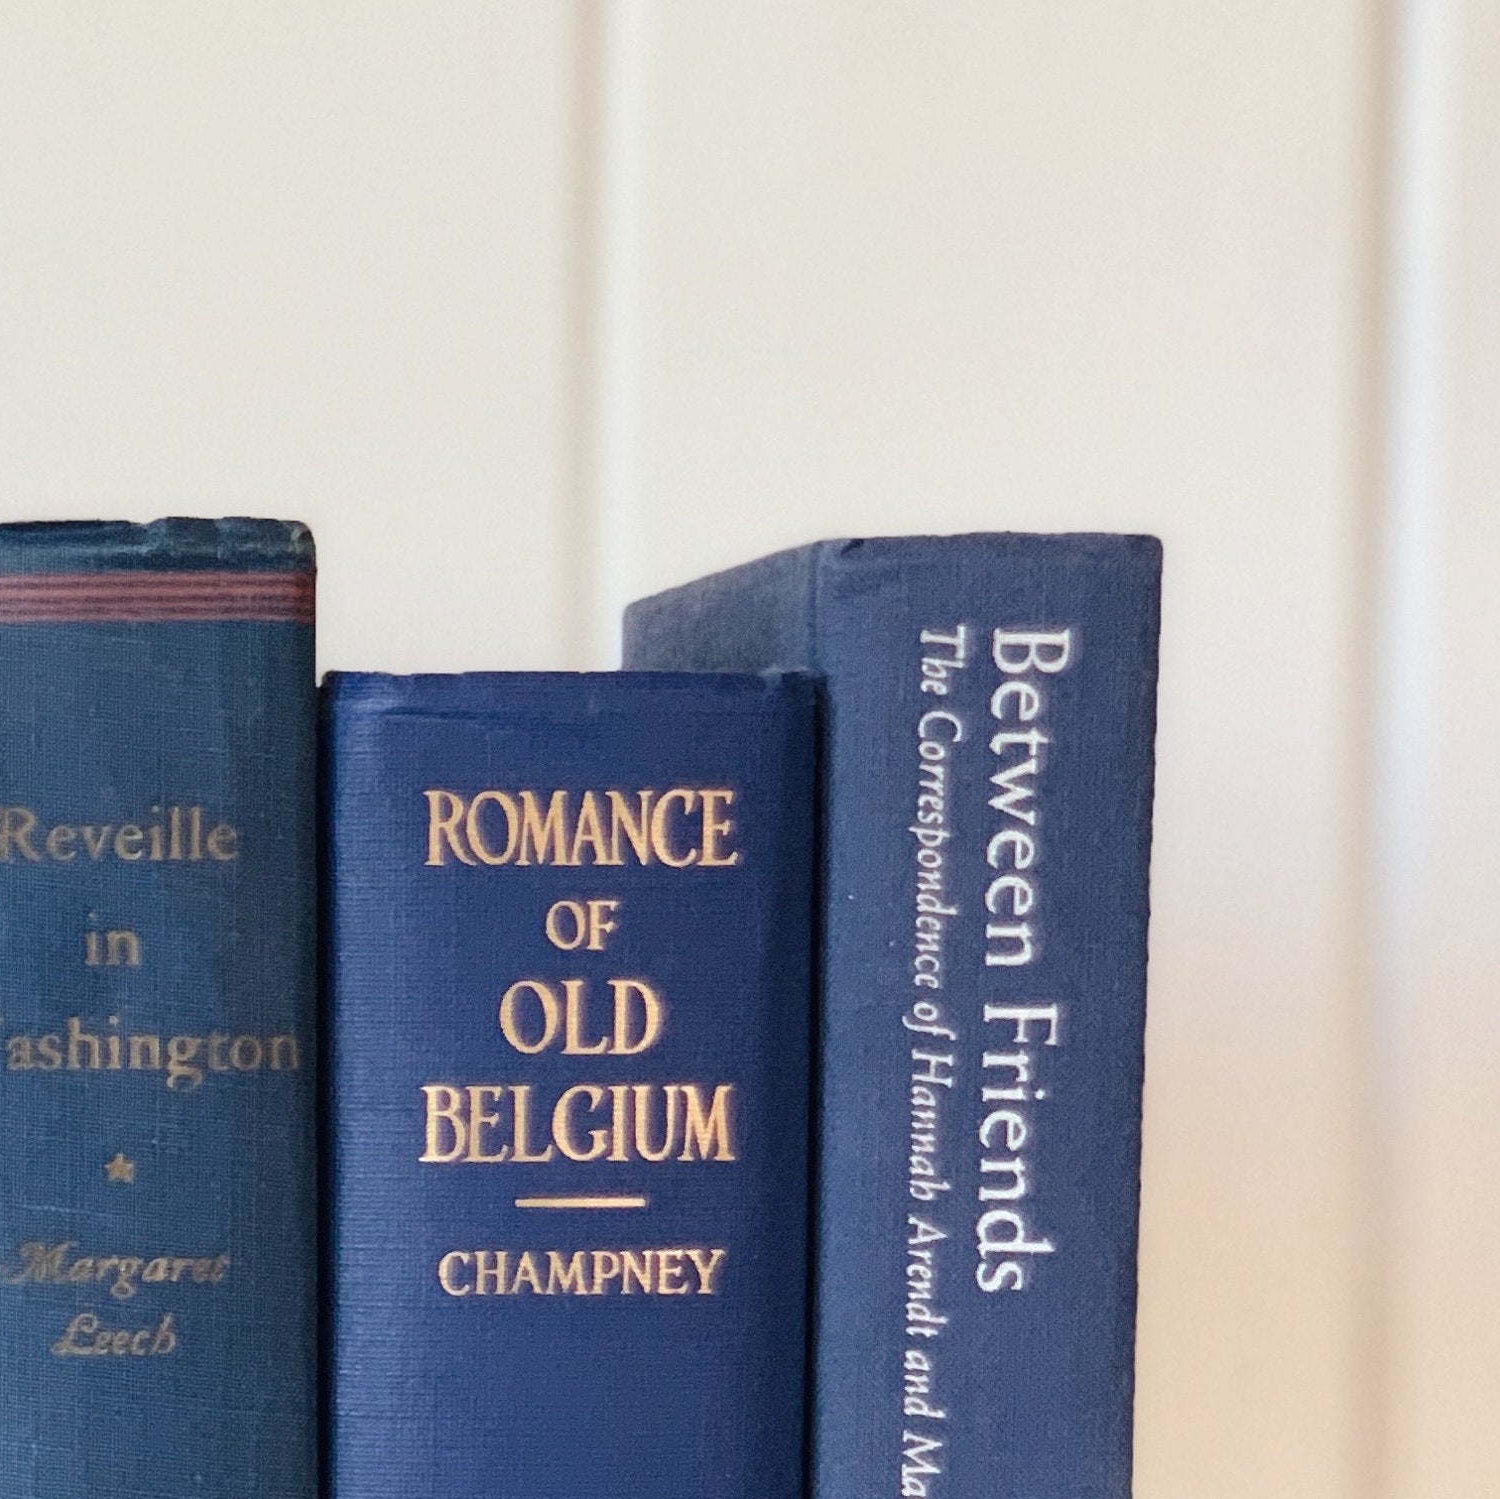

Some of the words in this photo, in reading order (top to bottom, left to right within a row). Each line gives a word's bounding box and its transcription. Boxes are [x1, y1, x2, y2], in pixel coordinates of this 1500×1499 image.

[920, 625, 965, 695] The
[424, 789, 738, 867] ROMANCE
[984, 627, 1071, 967] Between
[908, 711, 962, 989] Correspondence
[84, 914, 141, 967] in
[545, 901, 618, 950] OF
[500, 981, 662, 1055] OLD
[902, 1001, 956, 1041] of
[419, 1085, 736, 1164] BELGIUM
[909, 1049, 954, 1201] Hannah
[976, 1003, 1058, 1292] Friends
[439, 1249, 724, 1296] CHAMPNEY
[905, 1214, 948, 1338] Arendt
[52, 1312, 176, 1355] Leech
[903, 1349, 946, 1418] and
